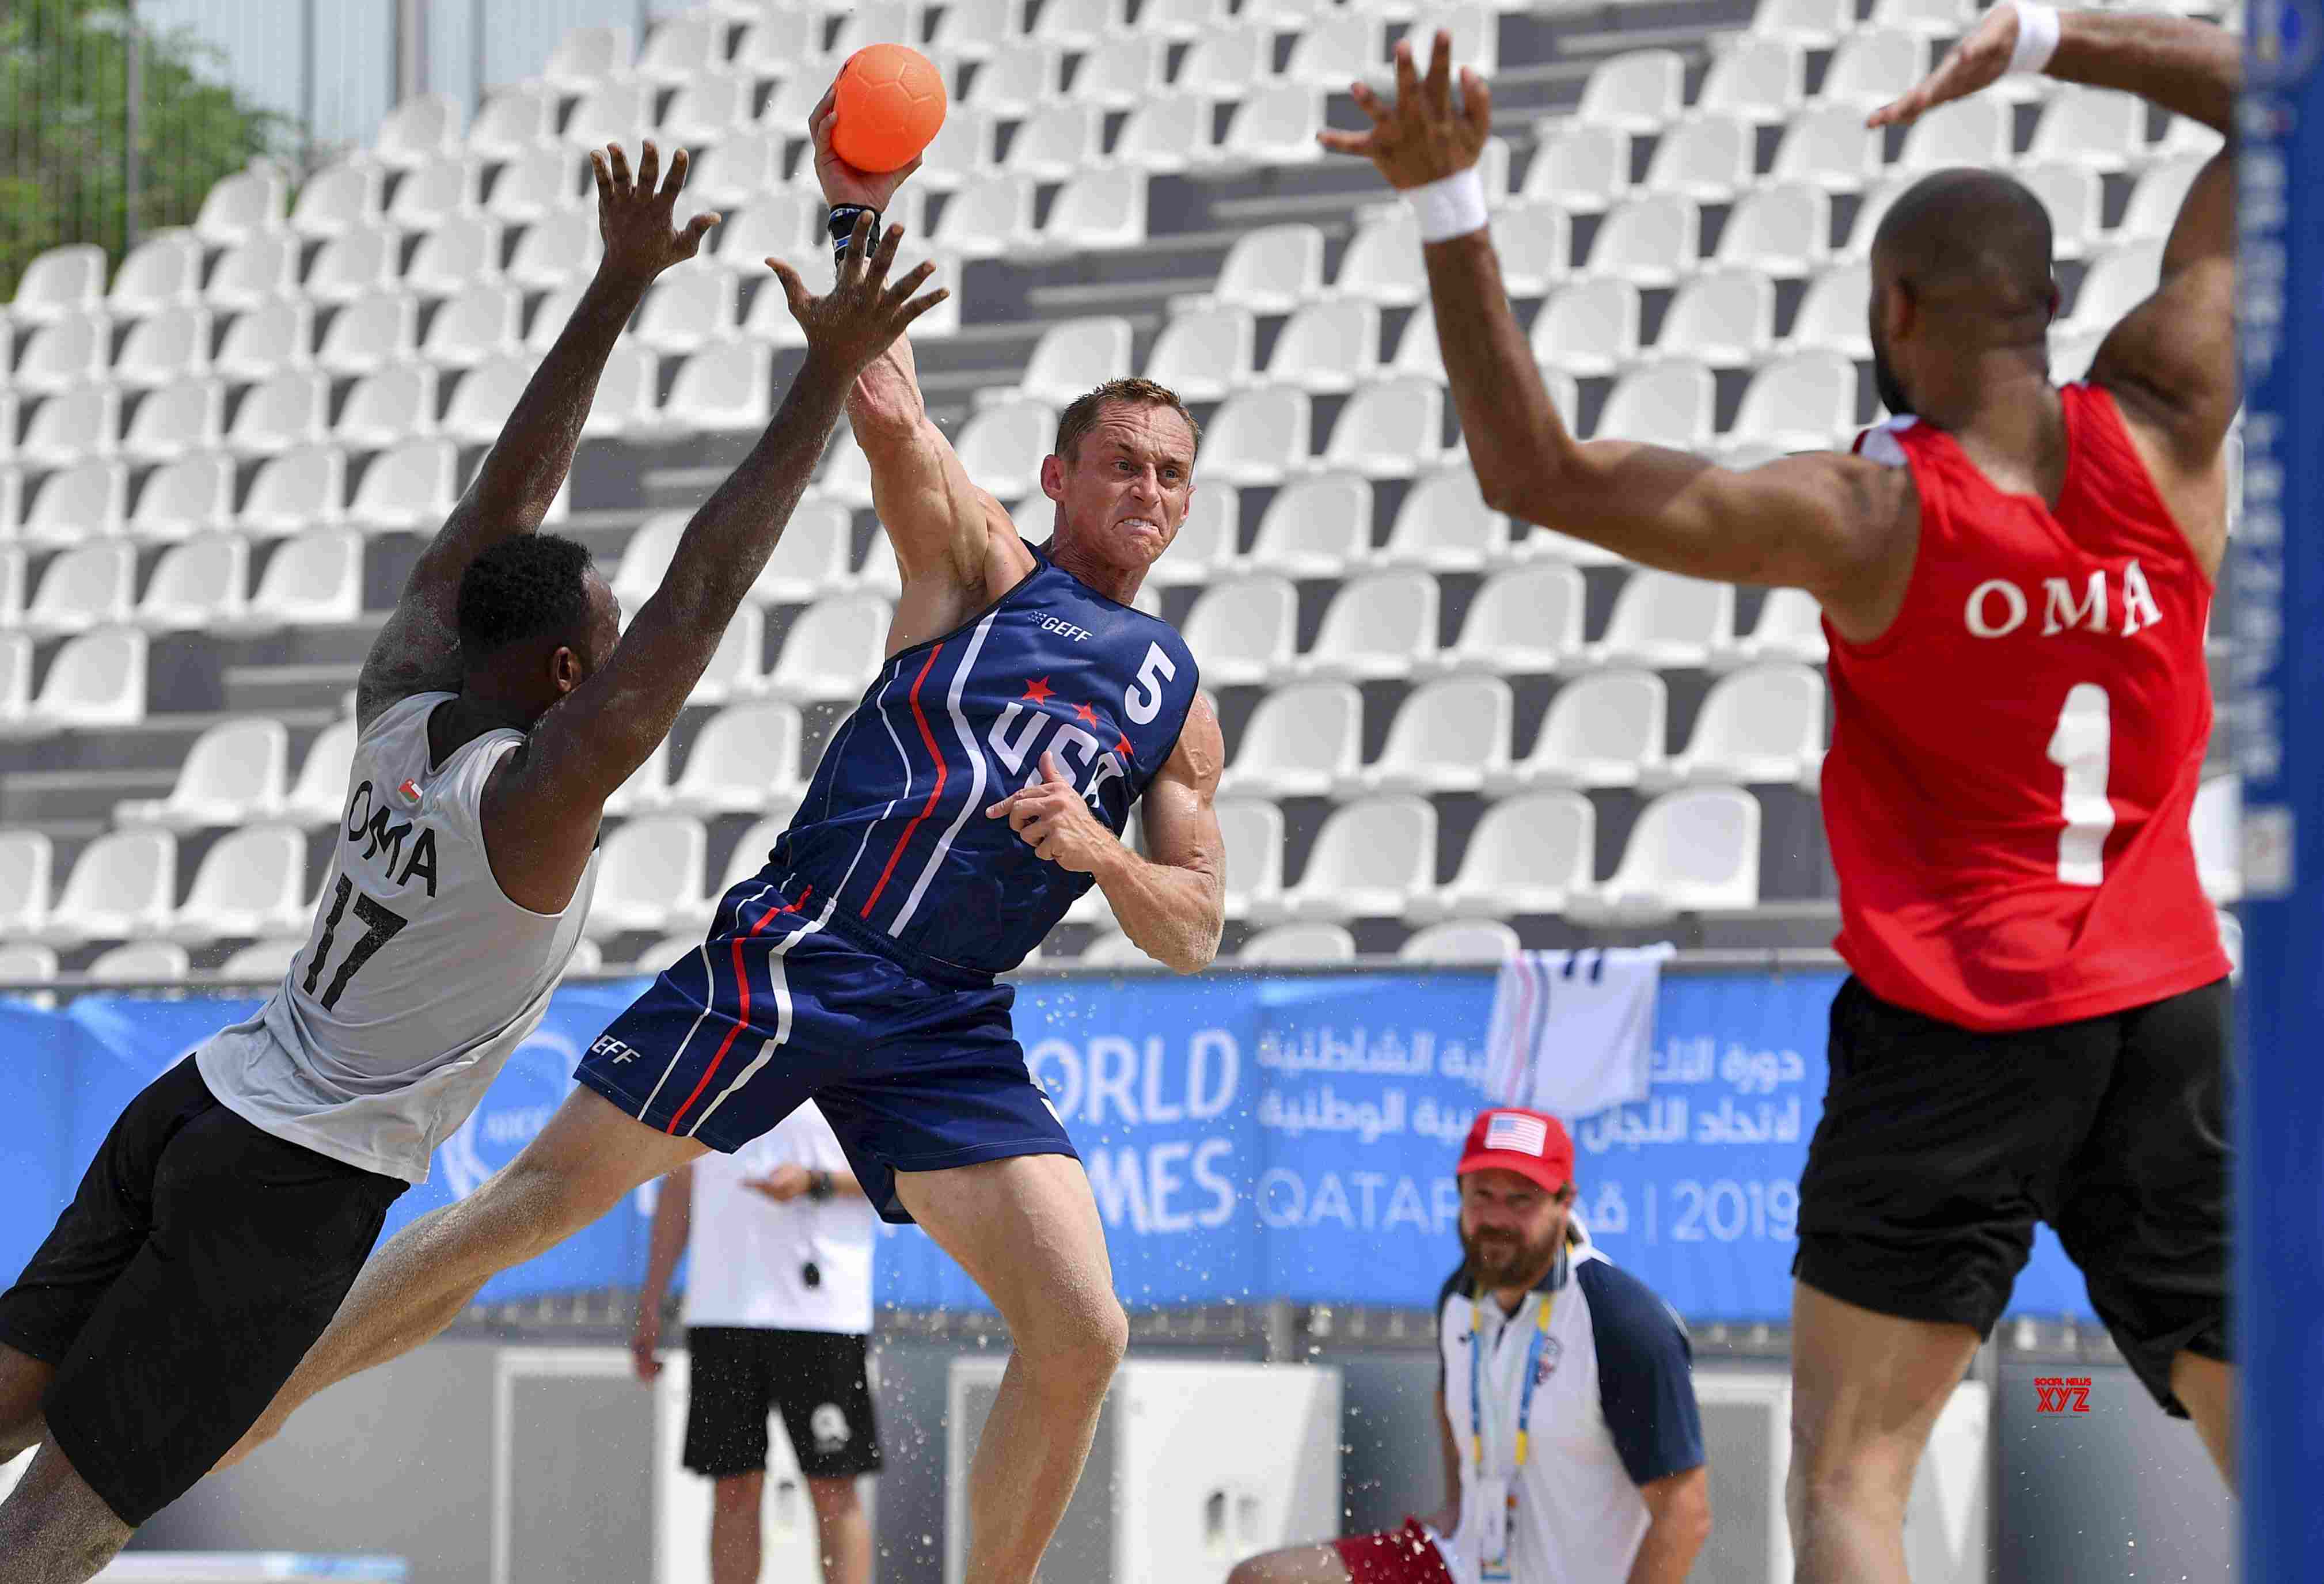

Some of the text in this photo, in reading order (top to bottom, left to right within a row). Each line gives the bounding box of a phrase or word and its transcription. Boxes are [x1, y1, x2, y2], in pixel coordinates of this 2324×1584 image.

[1041, 616, 1093, 643] GEFF
[1964, 559, 2163, 638] OMA
[1124, 640, 1176, 725] 5
[2046, 682, 2116, 886] 1
[348, 780, 438, 898] OMA
[302, 871, 409, 1013] 17
[591, 1034, 641, 1064] EFF
[1025, 1028, 1241, 1125] ORLD
[1719, 1042, 1806, 1095] دورة
[1086, 1137, 1237, 1236] MES
[1670, 1178, 1800, 1243] 2019
